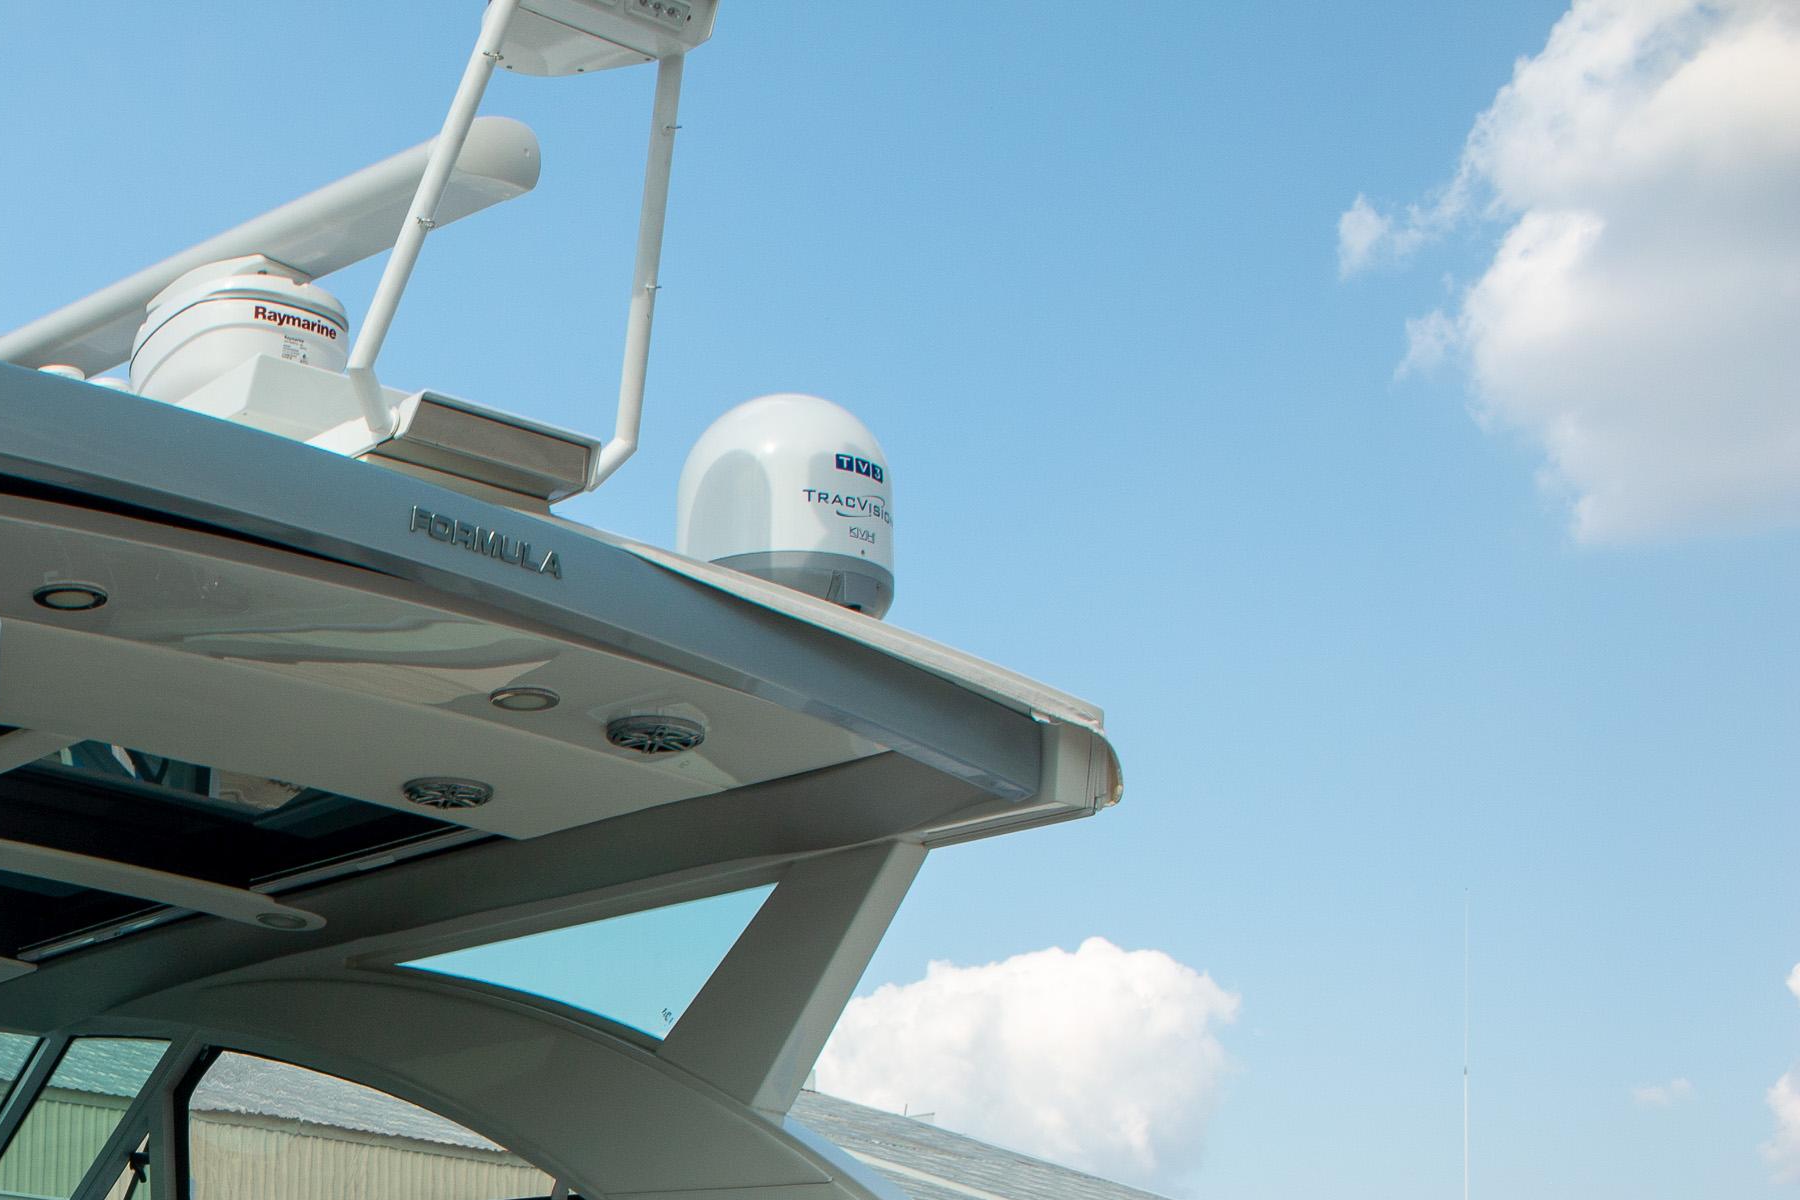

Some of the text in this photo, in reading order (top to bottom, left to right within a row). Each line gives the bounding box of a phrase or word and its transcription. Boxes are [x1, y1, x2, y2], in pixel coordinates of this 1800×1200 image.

[254, 306, 336, 340] Raymarine
[835, 454, 883, 483] TV3
[410, 505, 562, 580] FORMULA
